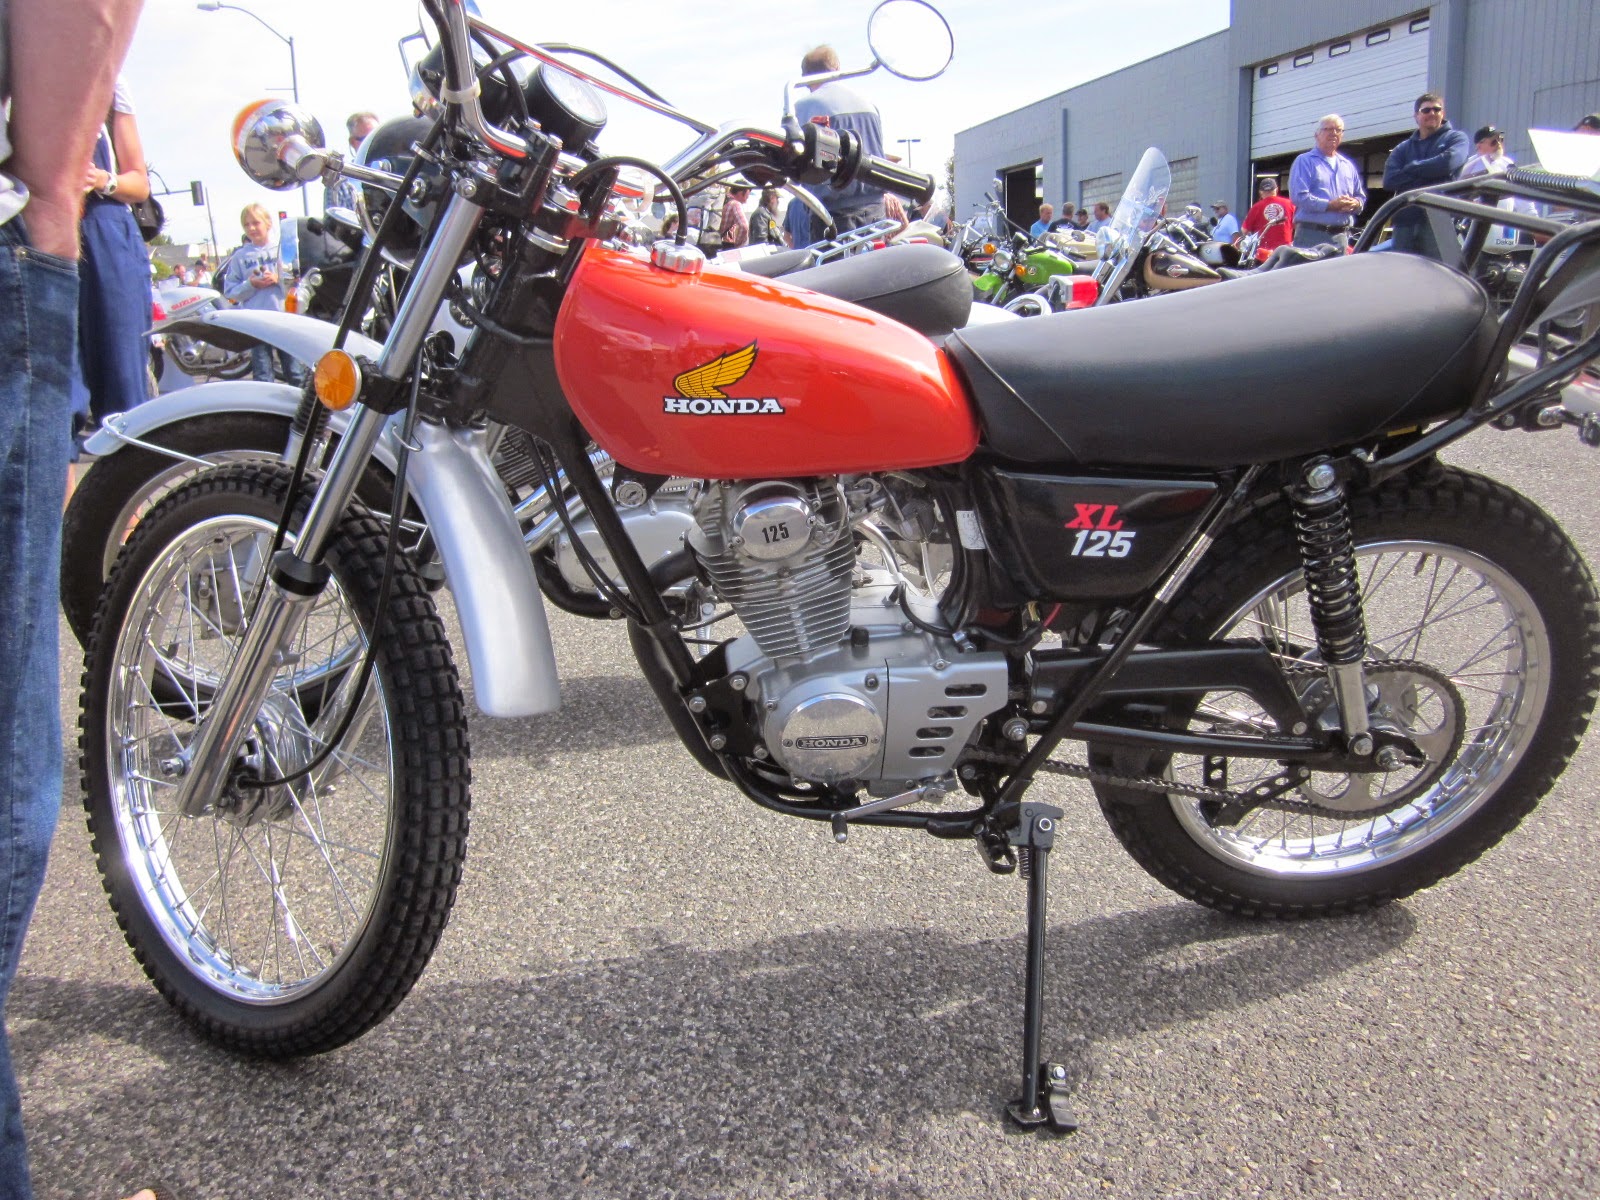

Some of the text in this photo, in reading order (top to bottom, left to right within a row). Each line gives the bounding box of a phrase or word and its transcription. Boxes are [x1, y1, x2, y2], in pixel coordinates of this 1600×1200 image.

[664, 397, 784, 415] HONDA
[1064, 503, 1124, 530] XL
[762, 521, 790, 544] 125
[1070, 529, 1137, 558] 125
[800, 737, 864, 749] HONDA
